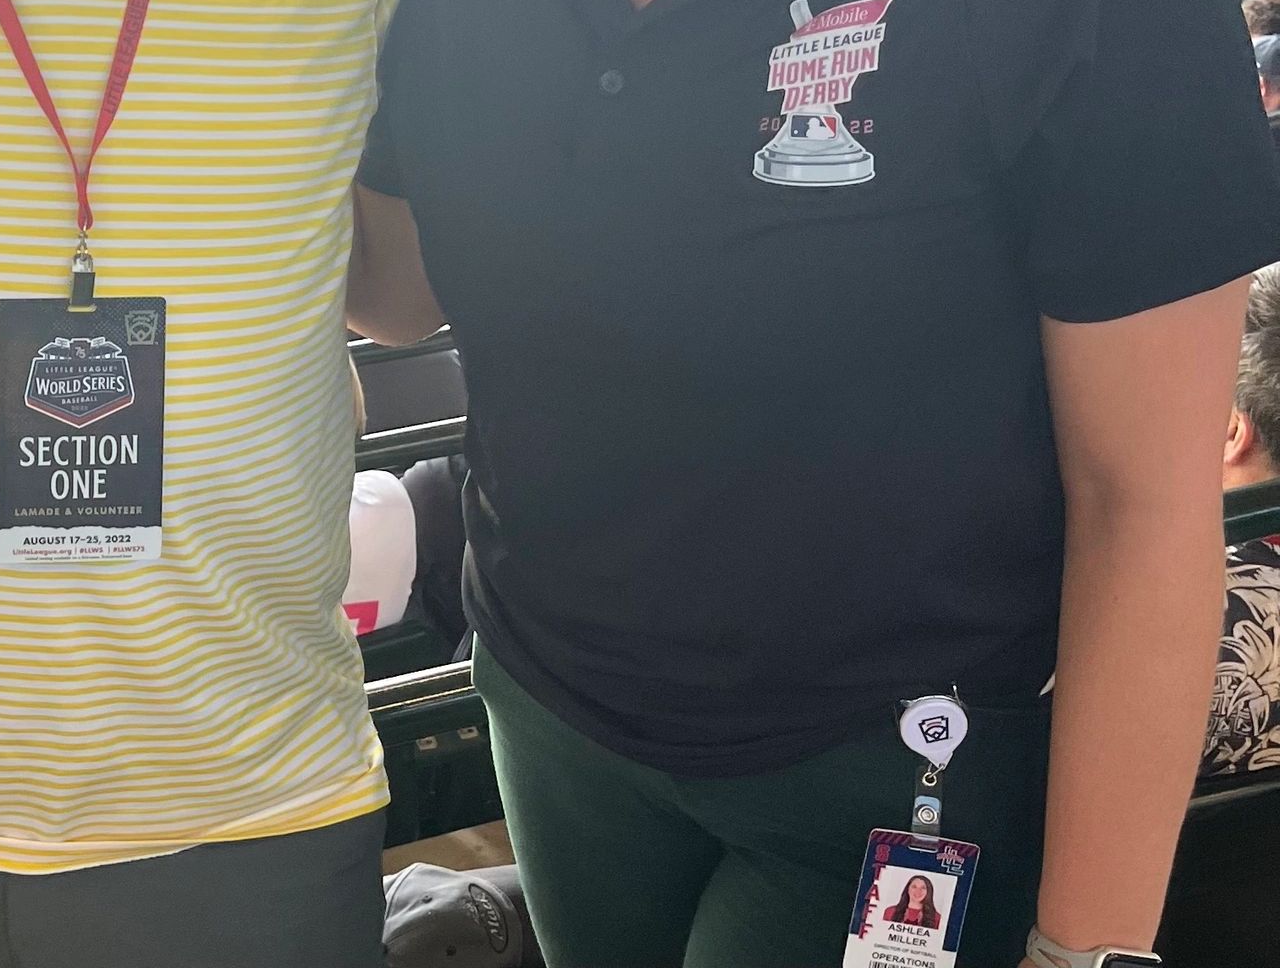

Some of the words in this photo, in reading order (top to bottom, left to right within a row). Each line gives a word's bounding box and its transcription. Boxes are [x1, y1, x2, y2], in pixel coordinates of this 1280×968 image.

[773, 40, 820, 60] LITTLE
[823, 27, 883, 50] LEAGUE
[771, 57, 829, 88] HOME
[831, 46, 876, 76] RUN
[104, 68, 125, 114] LITTLE
[783, 77, 854, 111] DERBY
[759, 118, 781, 131] 20
[850, 120, 873, 133] 22
[75, 347, 86, 358] 75
[36, 377, 80, 395] WORLD
[83, 376, 125, 393] SERIES
[62, 396, 98, 405] BASEBALL
[20, 434, 138, 467] SECTION
[51, 469, 107, 500] ONE
[14, 507, 60, 516] LAMADE
[78, 506, 143, 515] VOLUNTEER
[23, 536, 66, 545] AUGUST
[105, 534, 131, 543] 2022
[858, 843, 890, 940] STAFF
[888, 923, 930, 938] ASHLEA
[888, 933, 927, 946] MILLER
[872, 951, 936, 968] OPERATIONS
